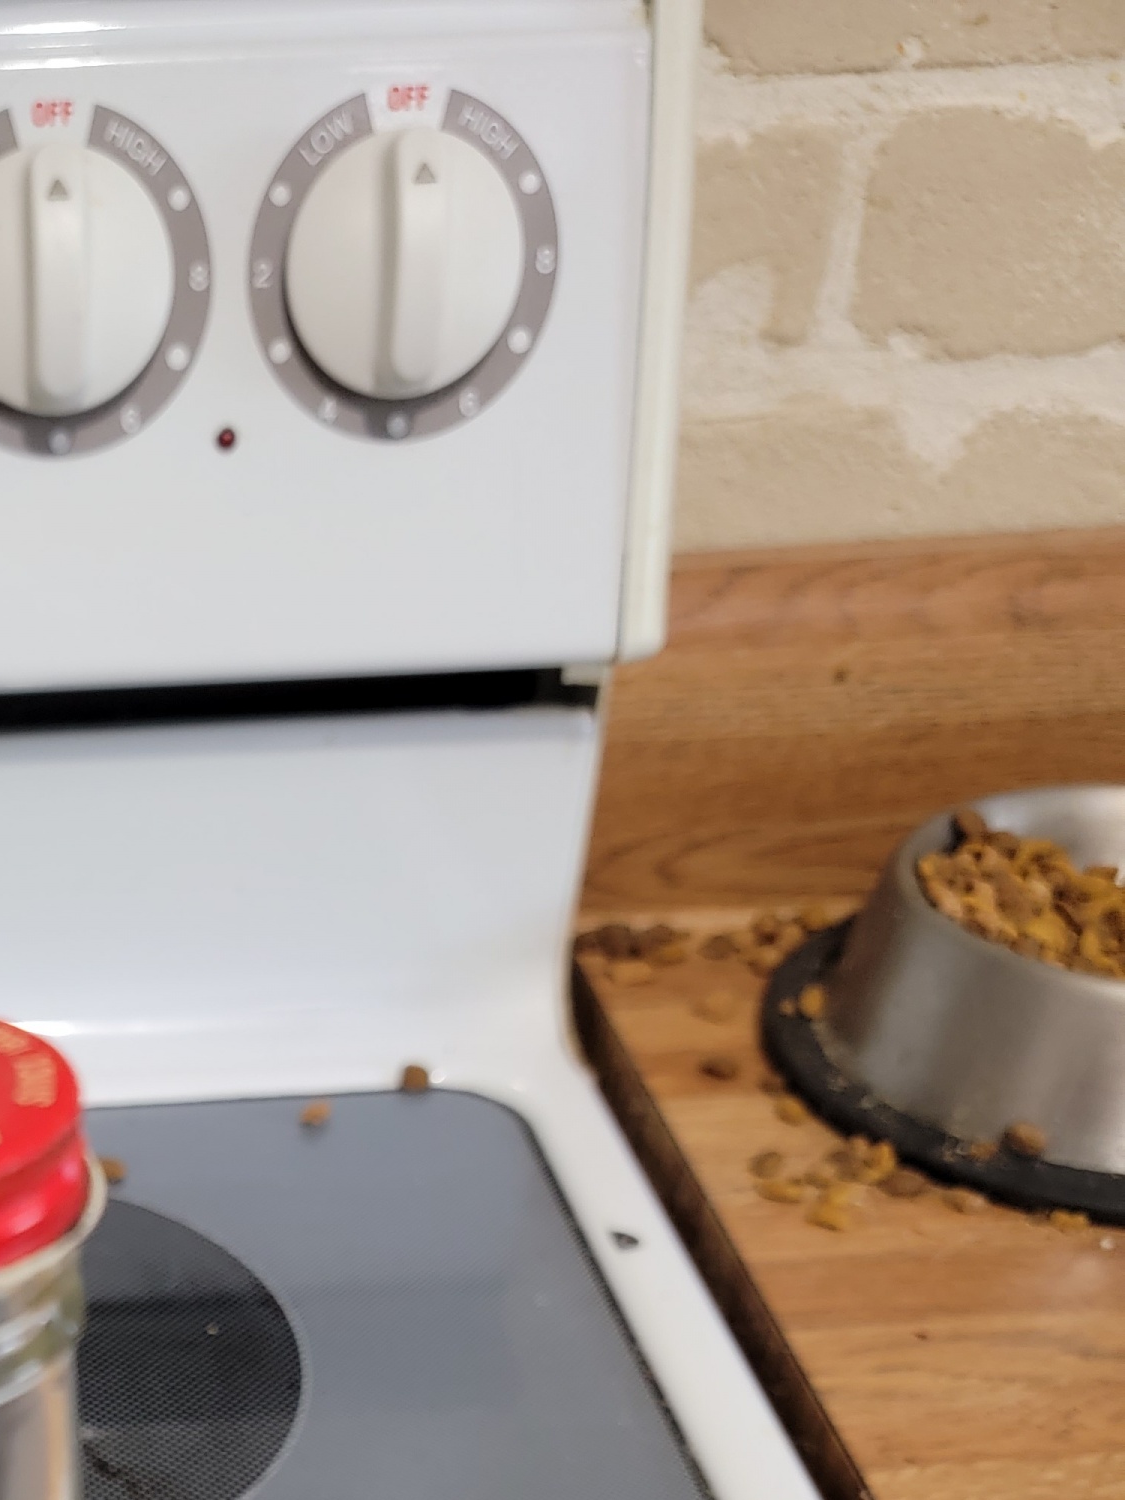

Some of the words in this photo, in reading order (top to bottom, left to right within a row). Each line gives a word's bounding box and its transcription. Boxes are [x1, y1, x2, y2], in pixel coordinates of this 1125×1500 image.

[387, 83, 429, 112] OFF
[31, 100, 73, 128] OFF
[299, 111, 355, 167] LOW
[458, 105, 520, 160] HIGH
[105, 118, 167, 177] HIGH
[253, 260, 273, 289] 2
[536, 246, 556, 275] 8
